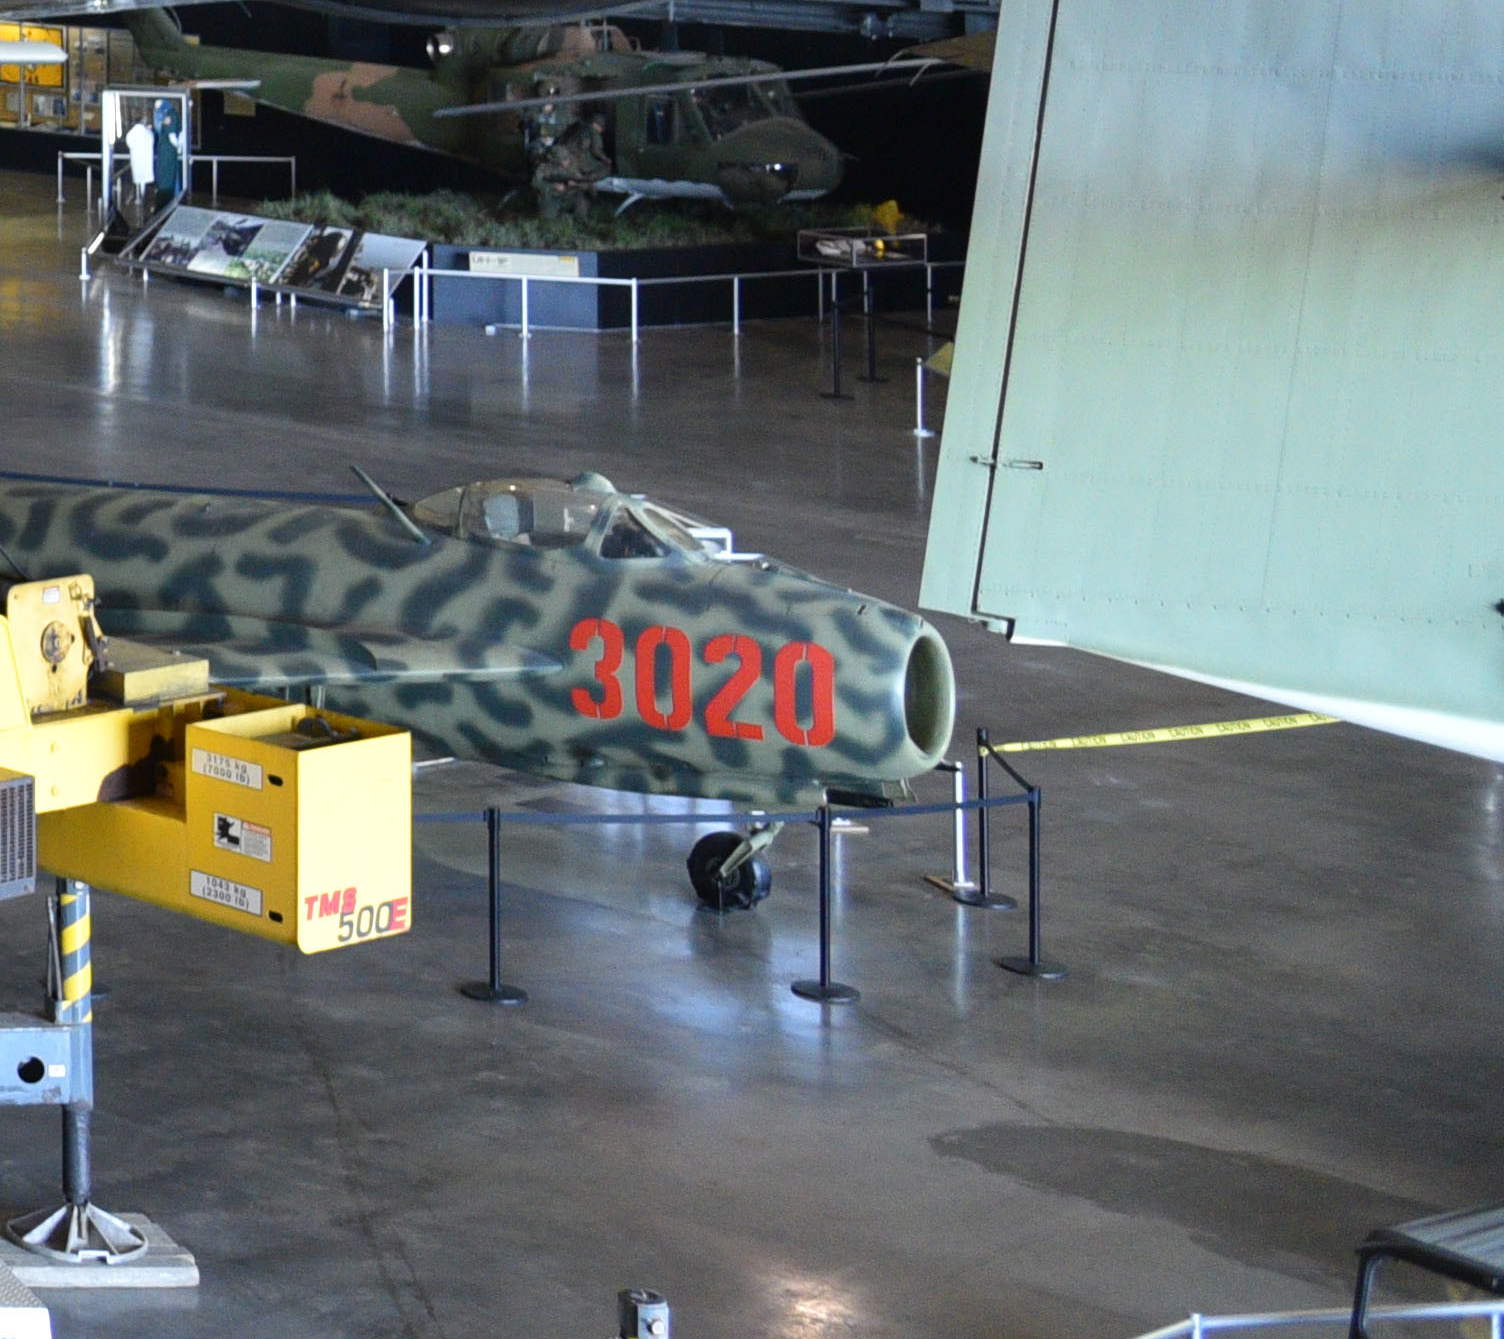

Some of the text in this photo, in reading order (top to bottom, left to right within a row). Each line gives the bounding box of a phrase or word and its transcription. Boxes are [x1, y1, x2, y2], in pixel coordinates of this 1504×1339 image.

[568, 616, 834, 747] 3020
[203, 763, 250, 785] (7000 lb)
[206, 753, 247, 774] 3175 kg
[202, 886, 249, 911] (2300 lb)
[206, 876, 246, 898] 1043 kg
[304, 886, 357, 920] TMS
[337, 896, 408, 942] 500E
